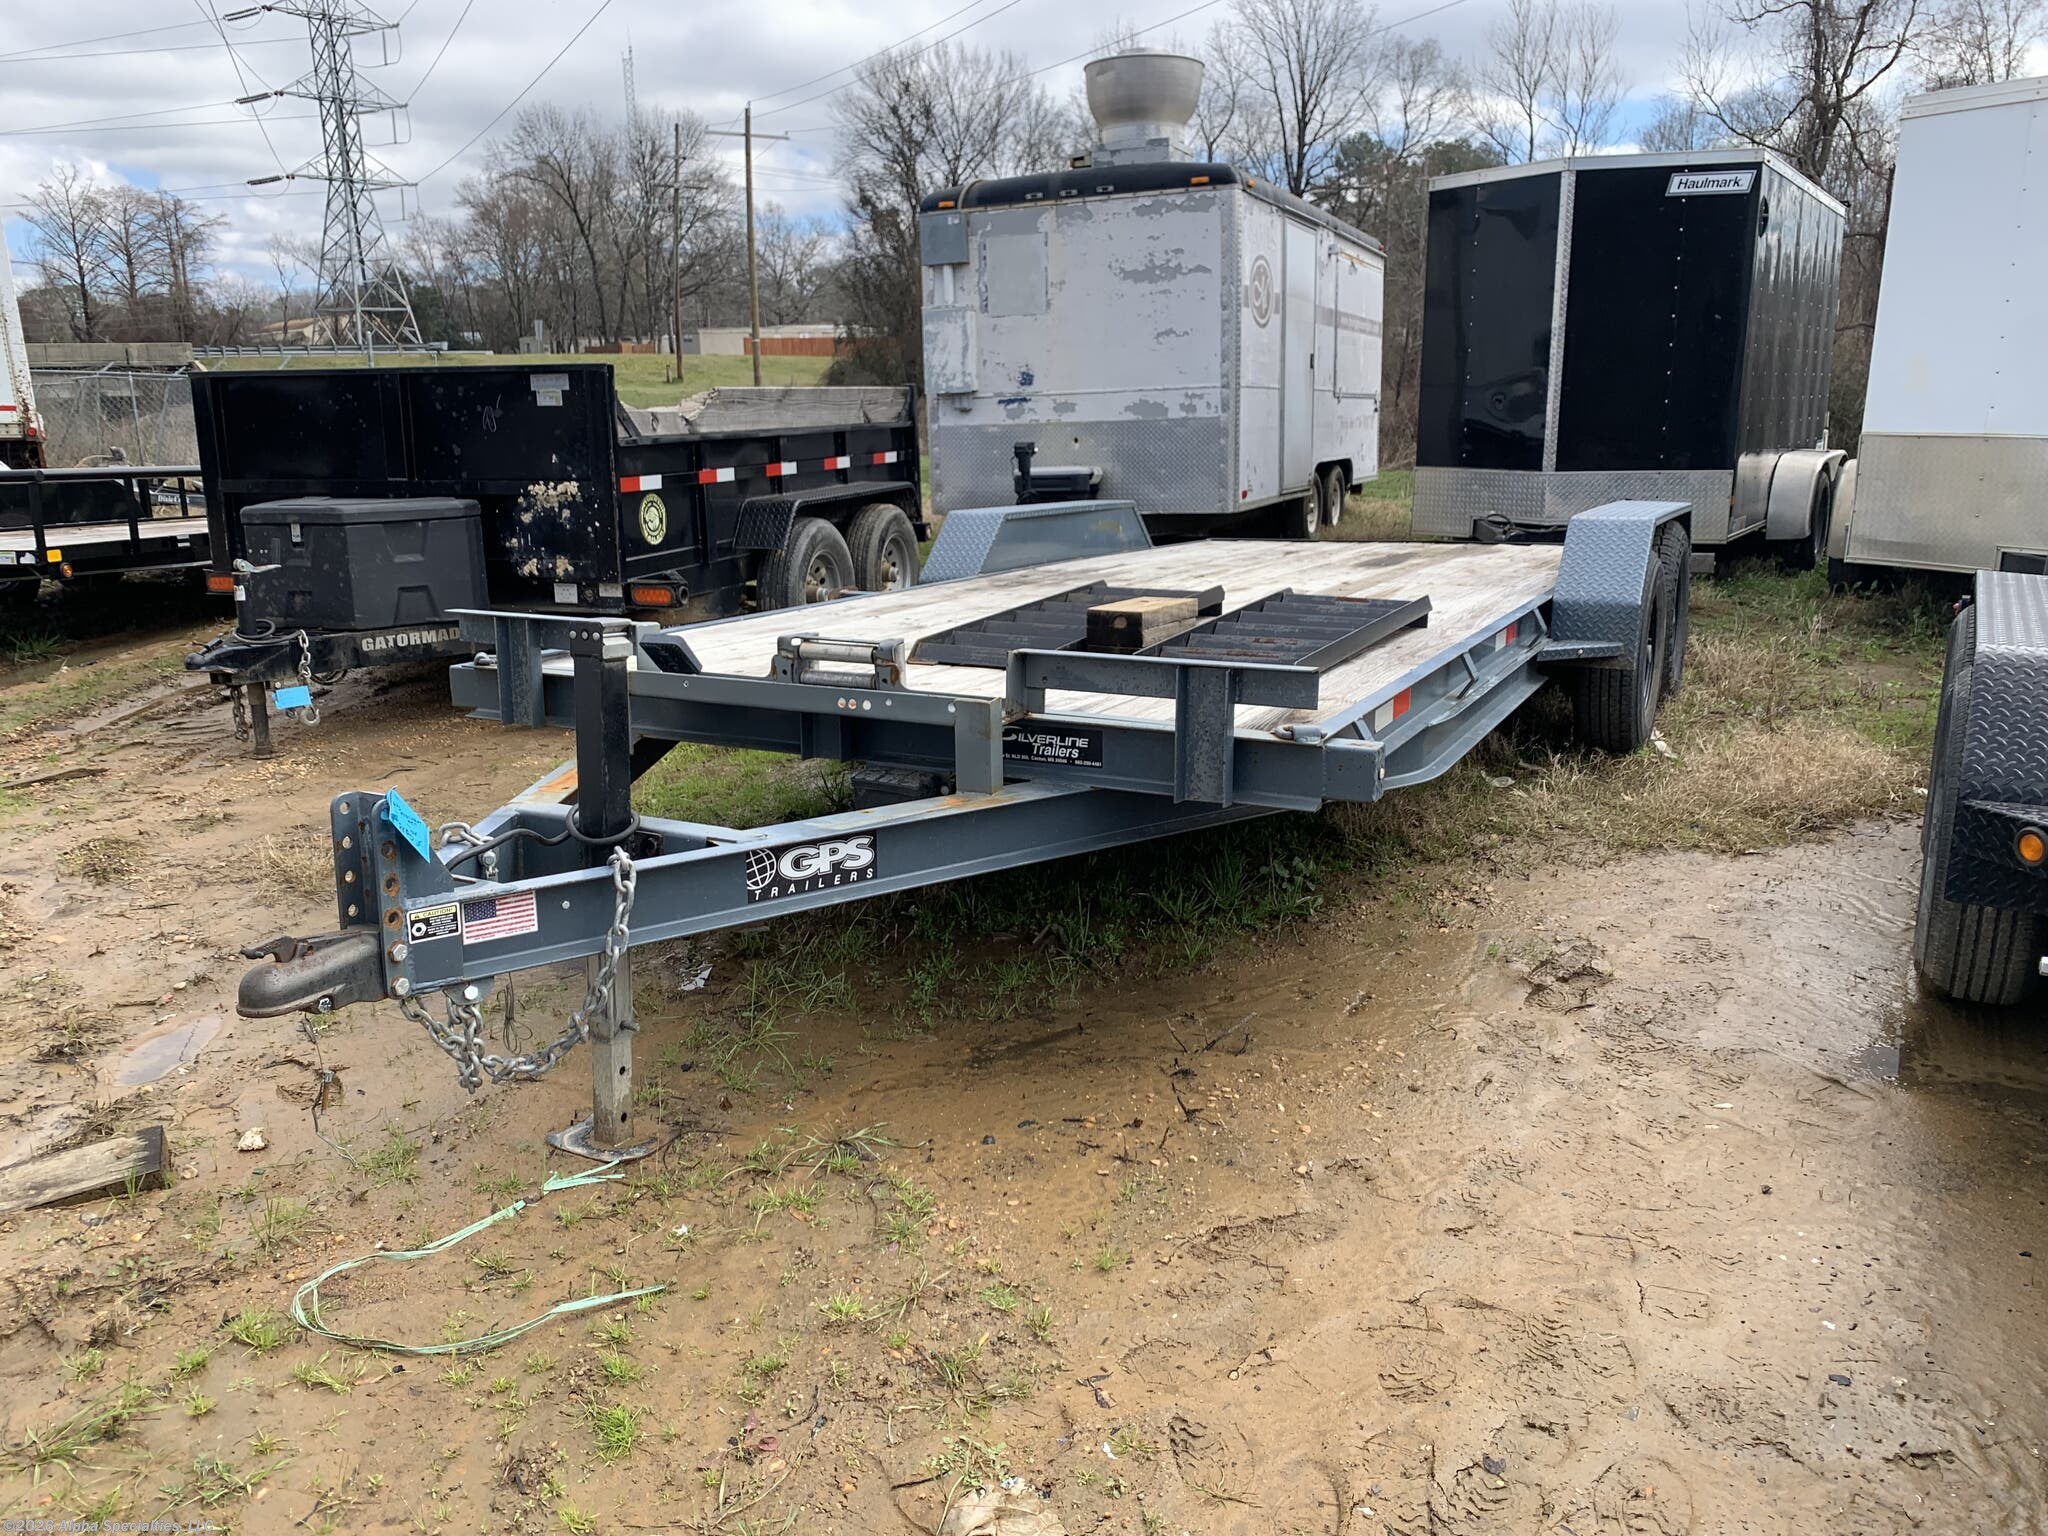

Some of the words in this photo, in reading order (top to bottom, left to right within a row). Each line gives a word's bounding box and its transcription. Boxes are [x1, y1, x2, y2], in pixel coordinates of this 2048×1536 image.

[1677, 176, 1741, 190] Haulmark
[361, 627, 460, 651] GATORMAD
[1032, 743, 1079, 758] Trailers
[778, 835, 874, 880] GPS
[755, 868, 874, 901] TRAILERS
